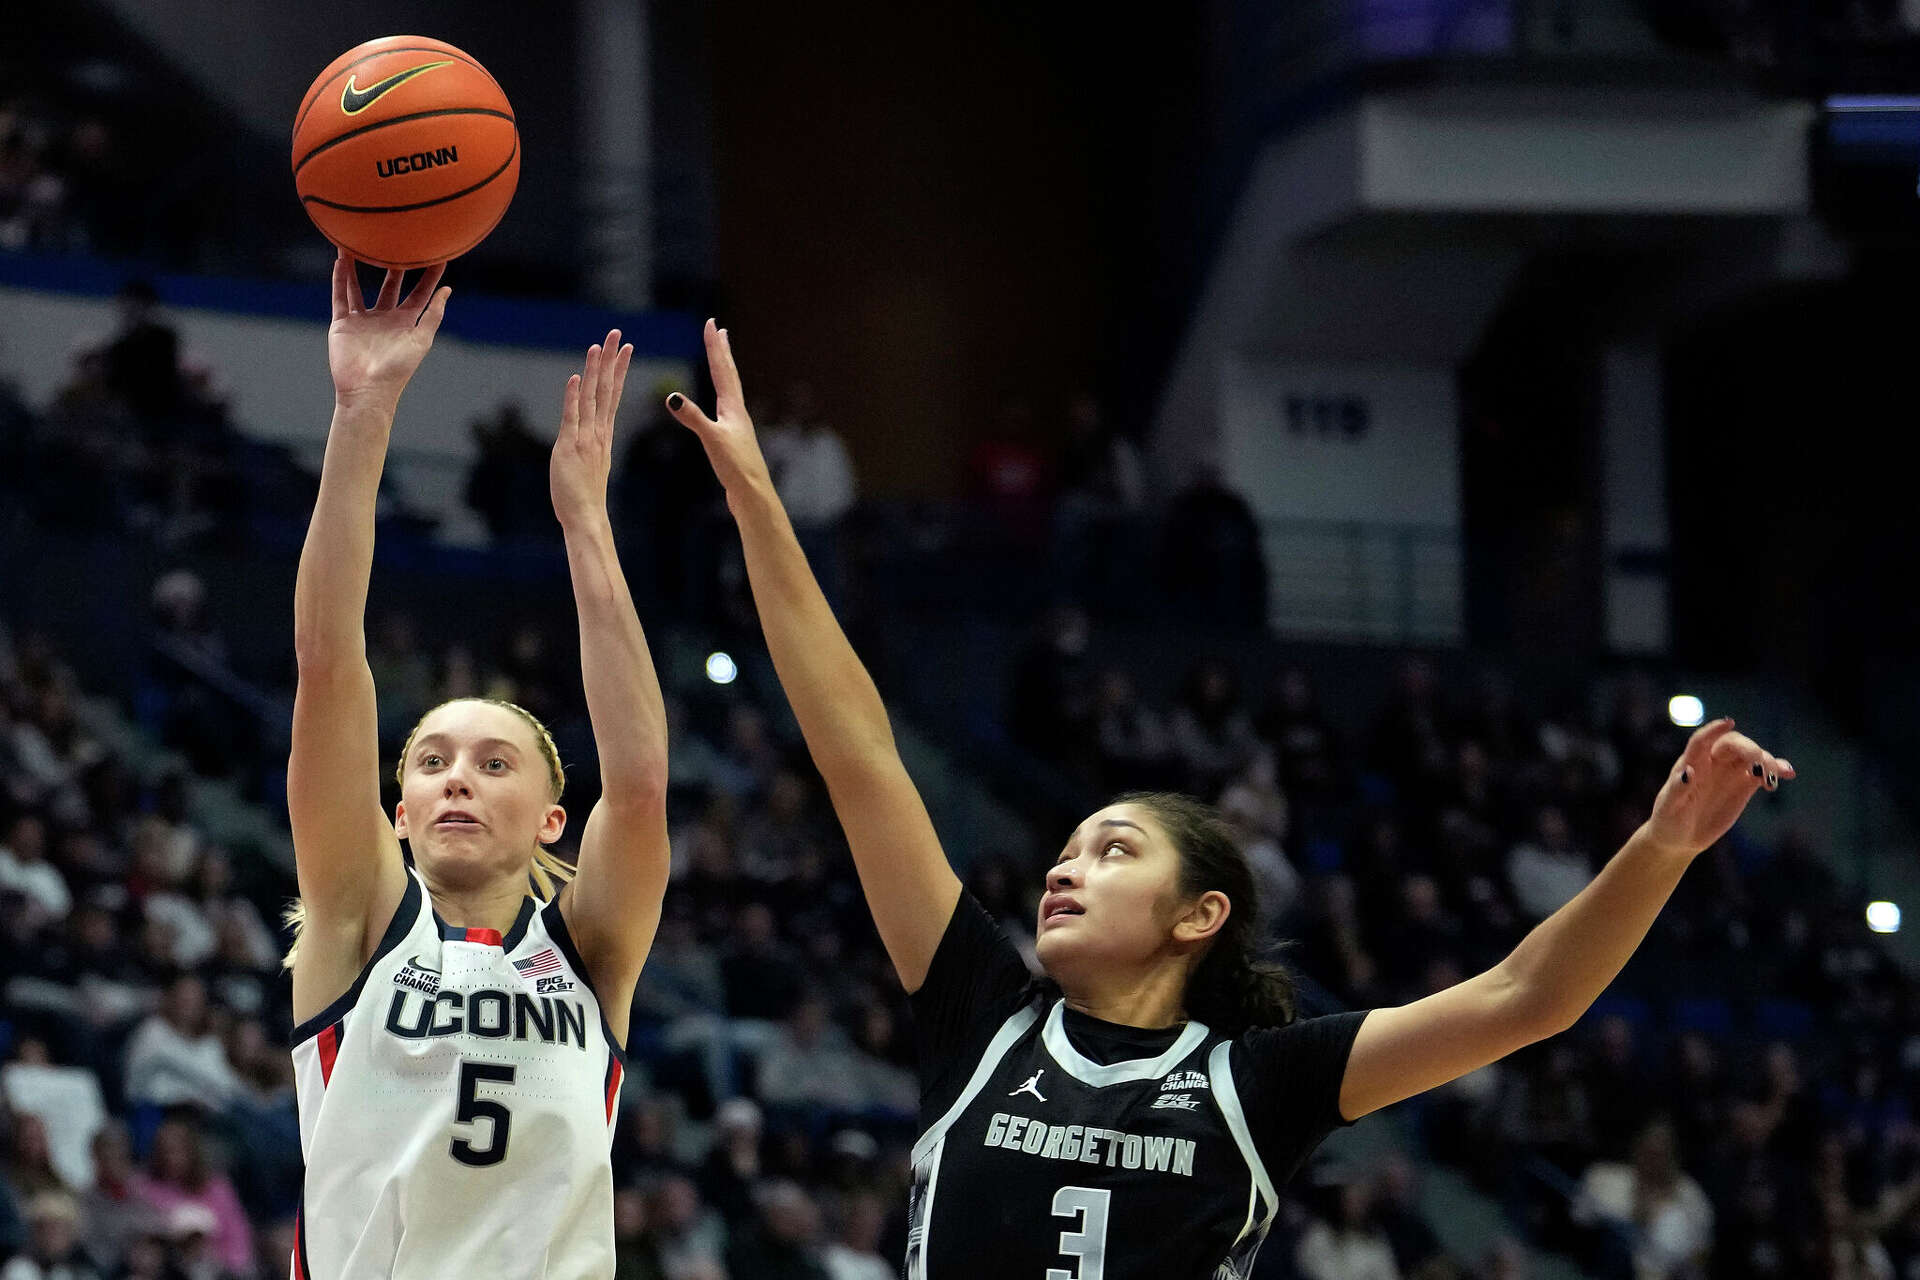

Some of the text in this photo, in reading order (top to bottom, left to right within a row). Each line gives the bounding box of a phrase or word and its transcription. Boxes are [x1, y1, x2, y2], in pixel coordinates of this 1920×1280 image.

[376, 145, 459, 179] UCONN
[393, 972, 440, 996] CHANGE
[401, 966, 441, 985] BE THE
[536, 975, 564, 988] BIG
[536, 982, 576, 994] EAST
[384, 988, 587, 1053] UCONN
[1160, 1079, 1210, 1092] CHANGE
[1166, 1071, 1208, 1083] BE THE
[1157, 1093, 1193, 1102] BIG
[449, 1058, 518, 1168] 5
[983, 1112, 1197, 1177] GEORGETOWN
[1046, 1185, 1112, 1280] 3
